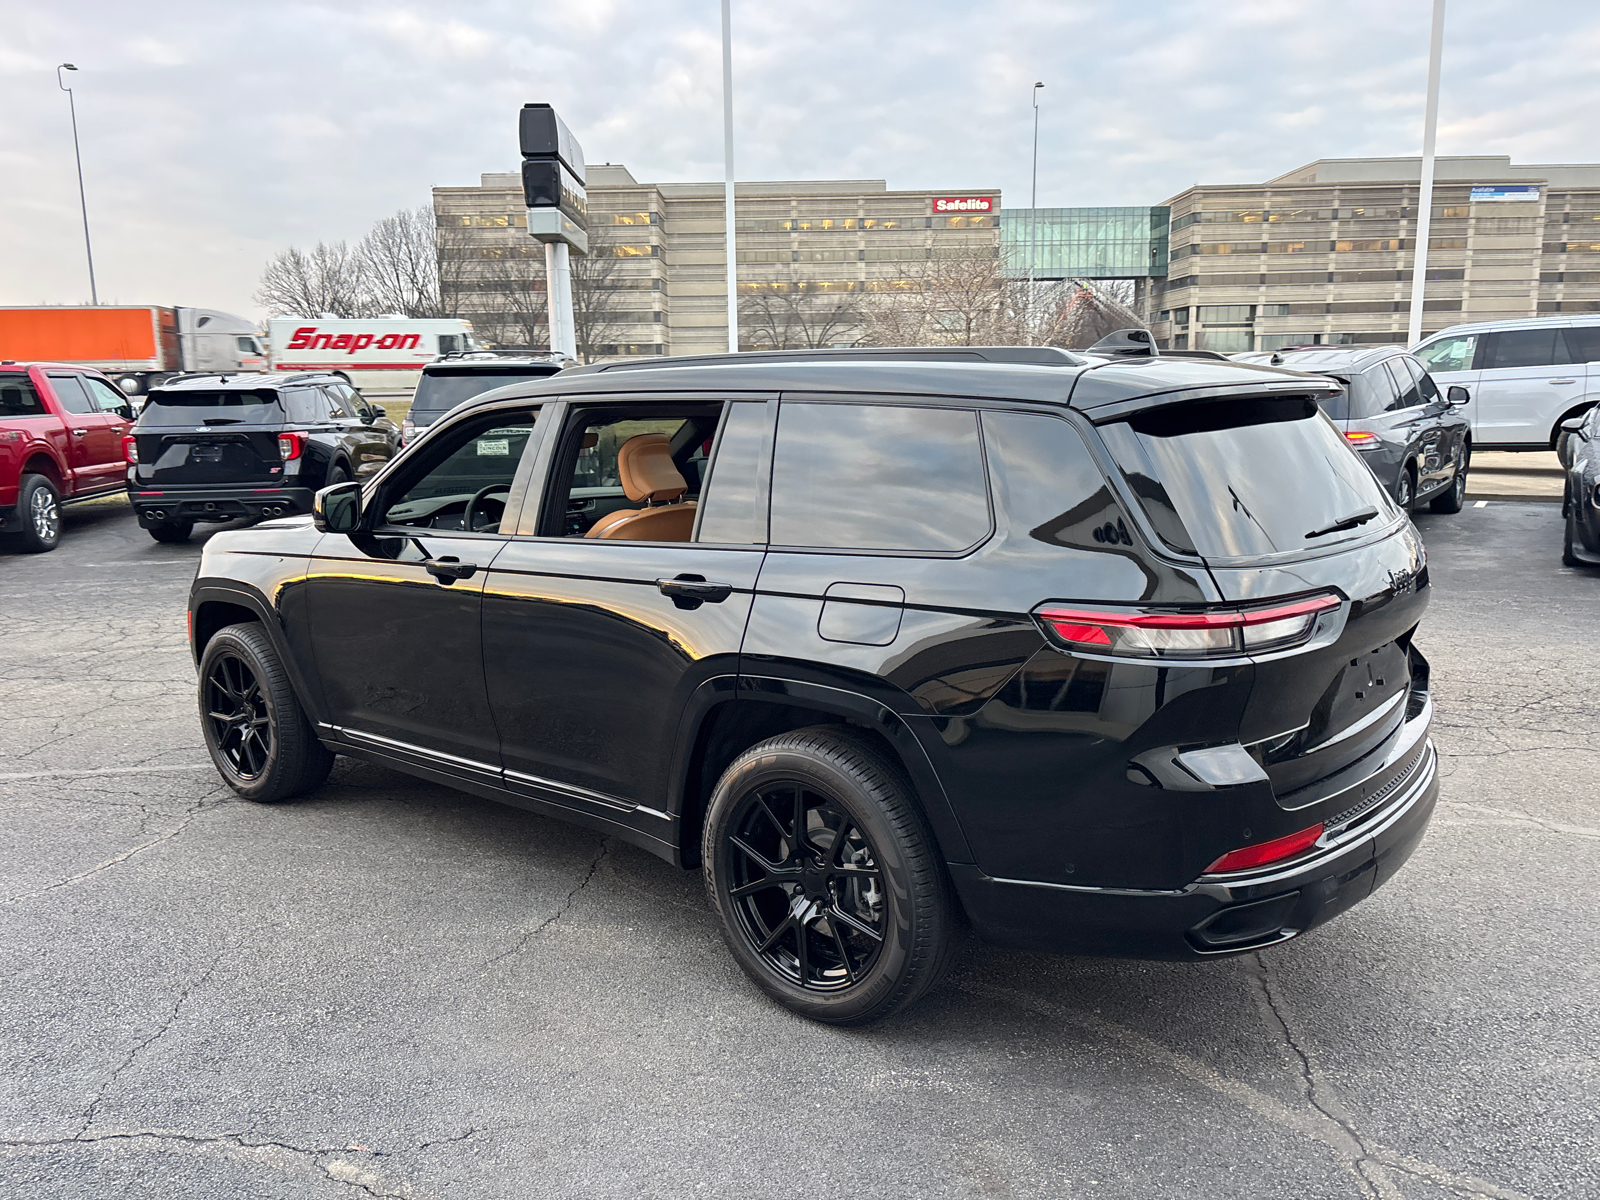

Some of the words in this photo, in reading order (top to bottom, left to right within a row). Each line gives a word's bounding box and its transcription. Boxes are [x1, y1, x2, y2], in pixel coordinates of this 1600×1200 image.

[936, 199, 989, 210] Safelite
[286, 327, 420, 354] Snap-on
[1387, 568, 1410, 590] Jeep
